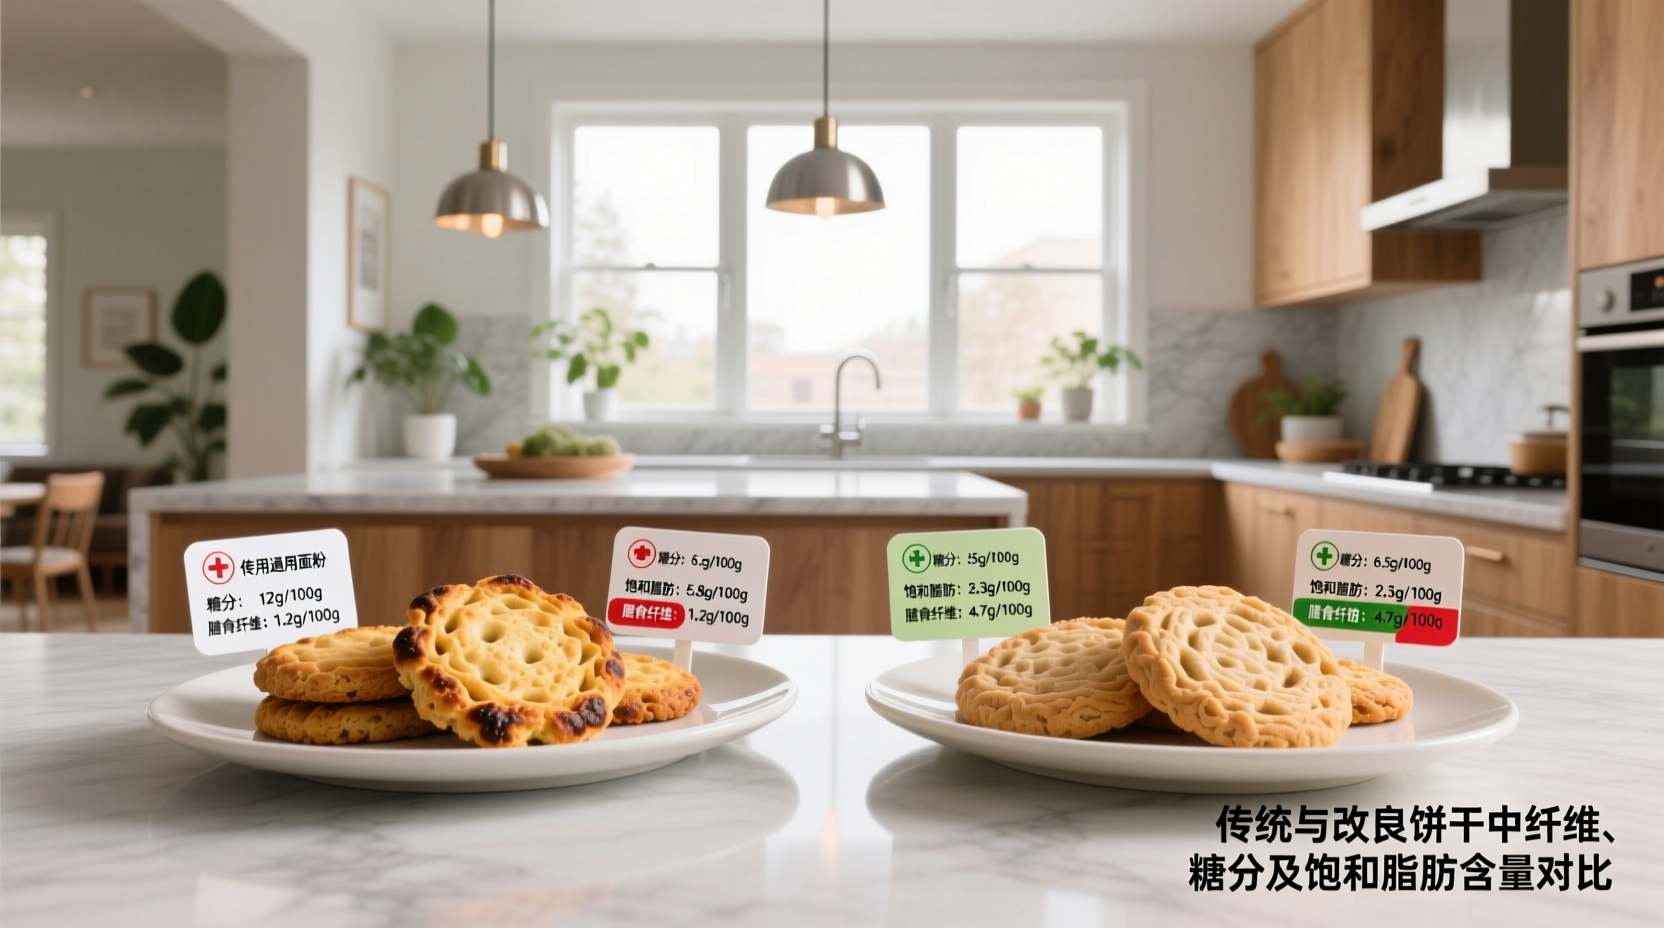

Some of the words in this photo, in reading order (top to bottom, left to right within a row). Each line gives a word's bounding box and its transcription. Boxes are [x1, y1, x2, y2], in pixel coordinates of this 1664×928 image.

[1373, 556, 1432, 575] 6.5g/100g
[259, 586, 323, 607] 12g/100g
[968, 580, 1031, 597] 2.3g/100g
[273, 607, 340, 629] 1.2g/100g
[688, 608, 750, 628] 1.2g/100g
[968, 603, 1033, 621] 4.7g/100g
[1374, 609, 1443, 630] 4.7g/100g
